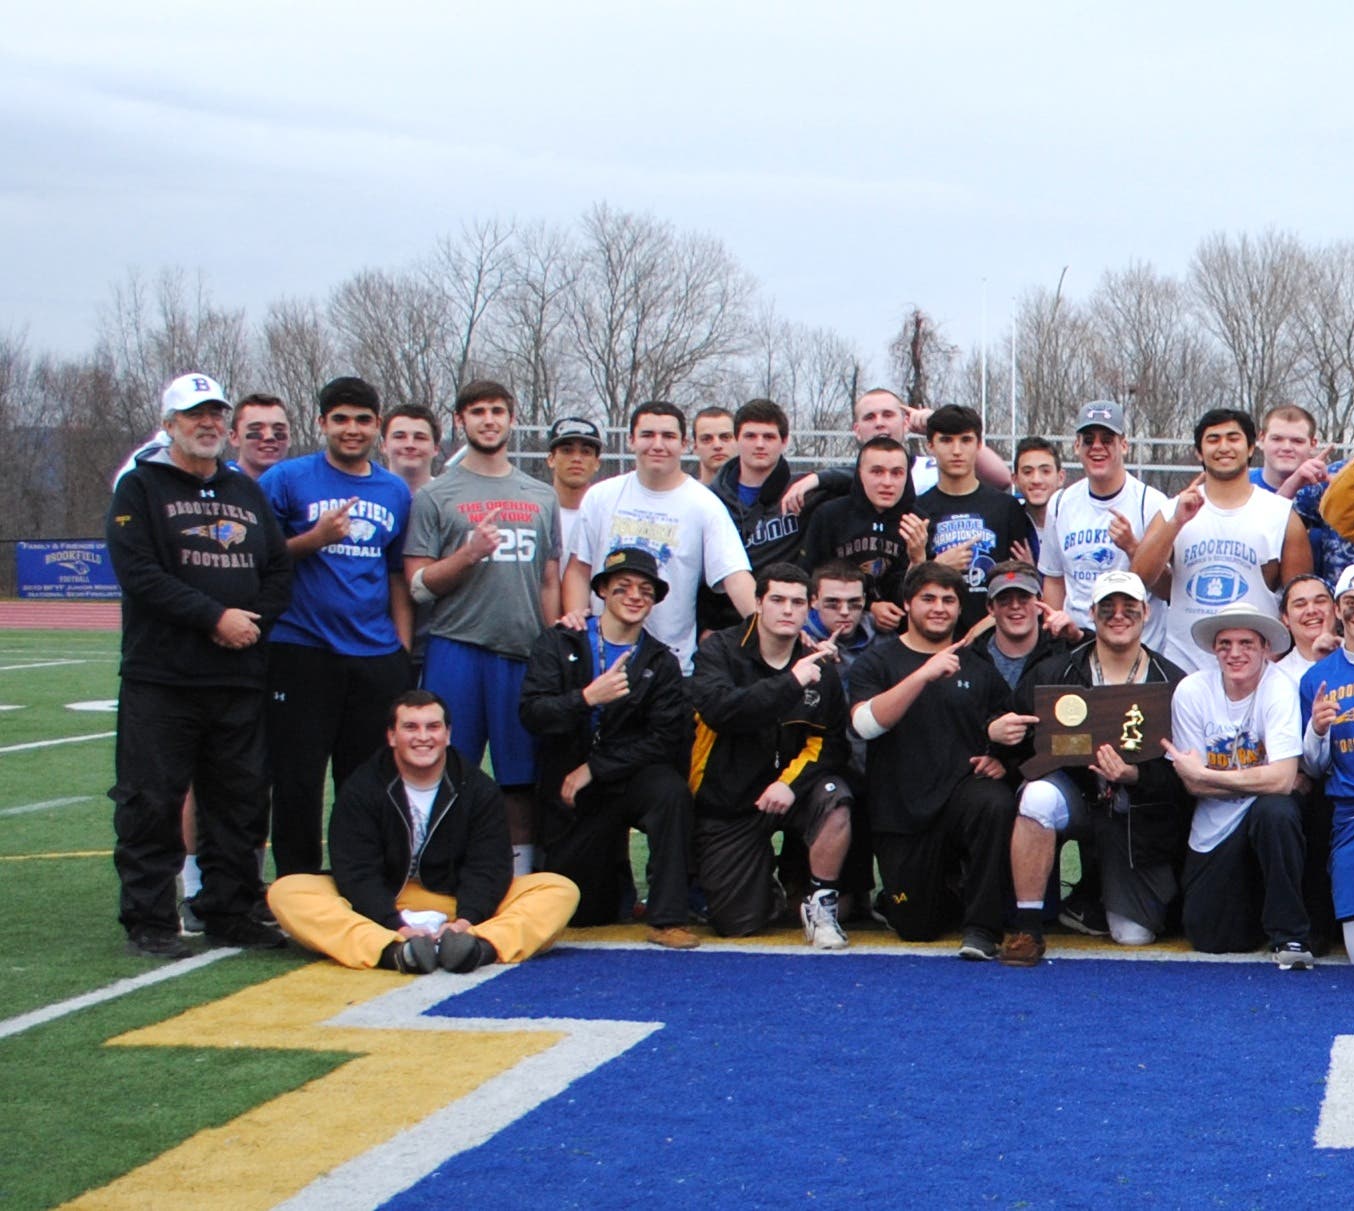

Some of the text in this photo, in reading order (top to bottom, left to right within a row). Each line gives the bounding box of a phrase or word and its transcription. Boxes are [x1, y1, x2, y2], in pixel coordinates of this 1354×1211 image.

[192, 377, 210, 392] B
[166, 500, 259, 526] BROOKFIELD
[181, 548, 255, 568] FOOTBALL
[1183, 538, 1258, 566] BROOKFIELD
